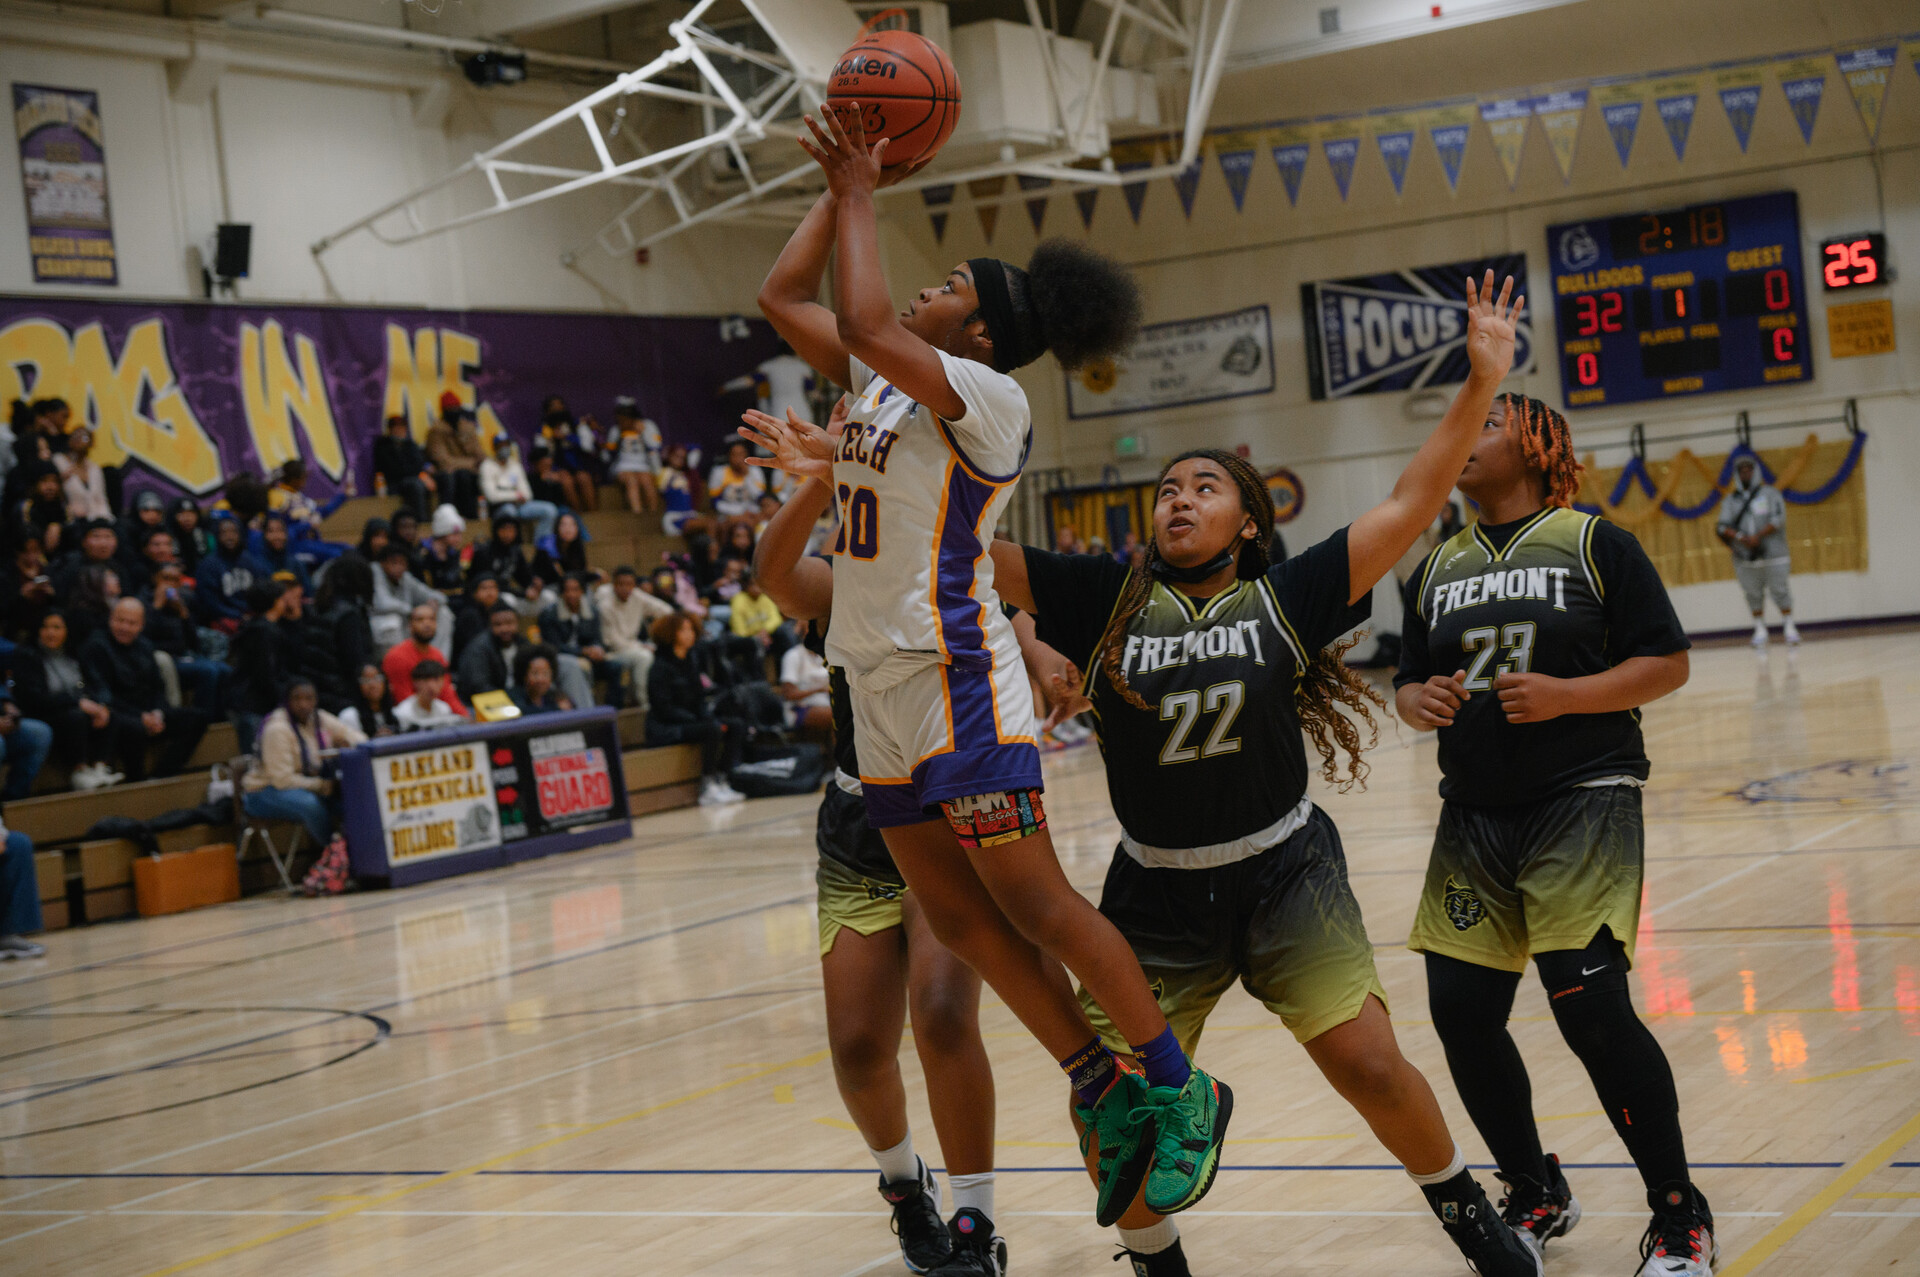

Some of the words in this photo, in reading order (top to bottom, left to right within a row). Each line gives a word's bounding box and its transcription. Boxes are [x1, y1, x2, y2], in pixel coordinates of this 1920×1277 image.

[837, 77, 859, 87] 28.5
[1639, 207, 1724, 255] 2:18
[1726, 244, 1783, 271] GUEST
[1824, 239, 1877, 287] 25
[1556, 264, 1644, 295] BULLDOGS
[1764, 269, 1790, 310] 0
[1576, 292, 1623, 336] 32
[1675, 288, 1686, 317] 1
[1340, 295, 1461, 378] FOCUS
[1577, 352, 1599, 385] 0
[238, 317, 347, 482] IN
[1430, 567, 1571, 631] FREMONT
[1120, 619, 1266, 686] FREMONT
[1462, 621, 1538, 692] 23
[1159, 679, 1246, 766] 22
[390, 749, 474, 783] OAKLAND
[387, 773, 486, 813] TECHNICAL
[538, 771, 613, 816] GUARD
[980, 806, 1025, 823] LEGACY
[392, 819, 457, 860] BULLDOGS
